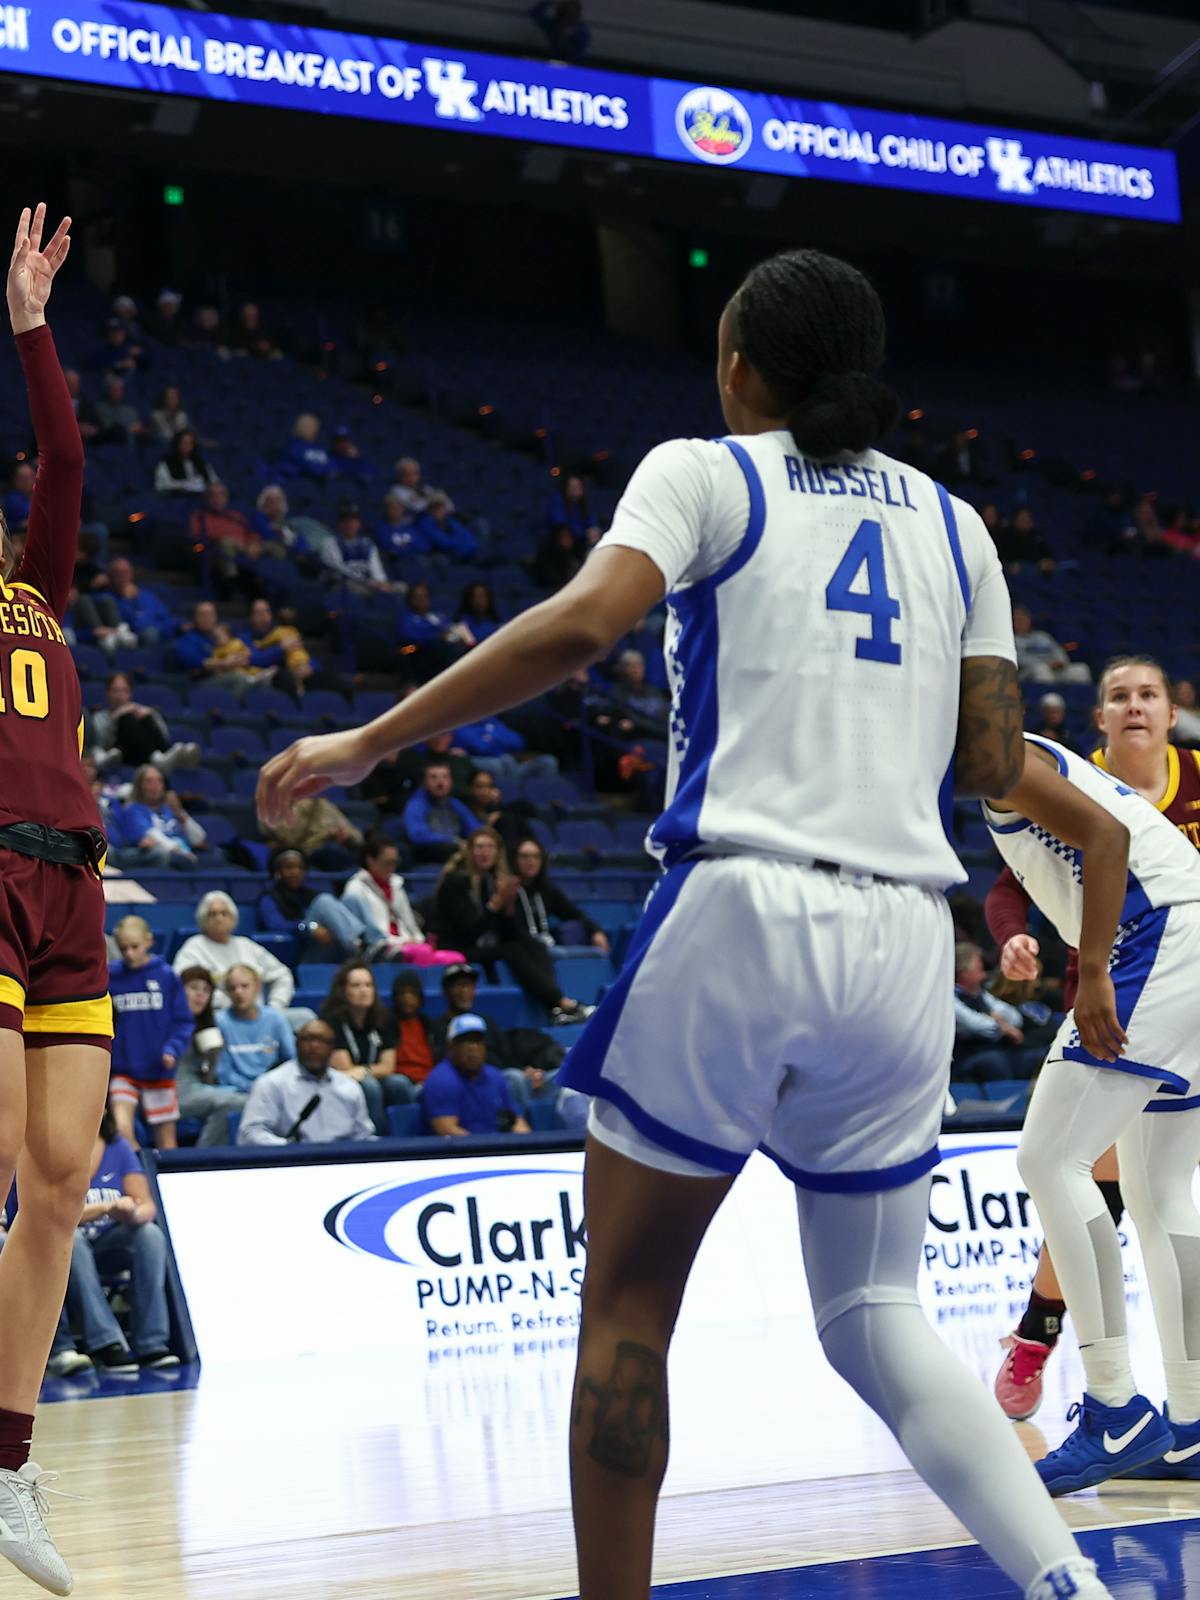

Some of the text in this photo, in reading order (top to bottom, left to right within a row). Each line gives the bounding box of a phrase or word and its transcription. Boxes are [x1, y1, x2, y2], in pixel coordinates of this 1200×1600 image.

[52, 18, 201, 72] OFFICIAL
[204, 39, 375, 95] BREAKFAST
[377, 65, 422, 101] OF
[422, 57, 483, 121] UK
[482, 79, 629, 130] ATHLETICS
[762, 118, 880, 165] OFFICIAL
[879, 135, 947, 174] CHILI
[948, 143, 985, 178] OF
[1033, 156, 1154, 200] ATHLETICS
[783, 454, 918, 512] RUSSELL
[826, 518, 902, 666] 4
[417, 1191, 587, 1268] Clark
[928, 1169, 1032, 1233] Clar
[416, 1268, 584, 1309] PUMP-N-S
